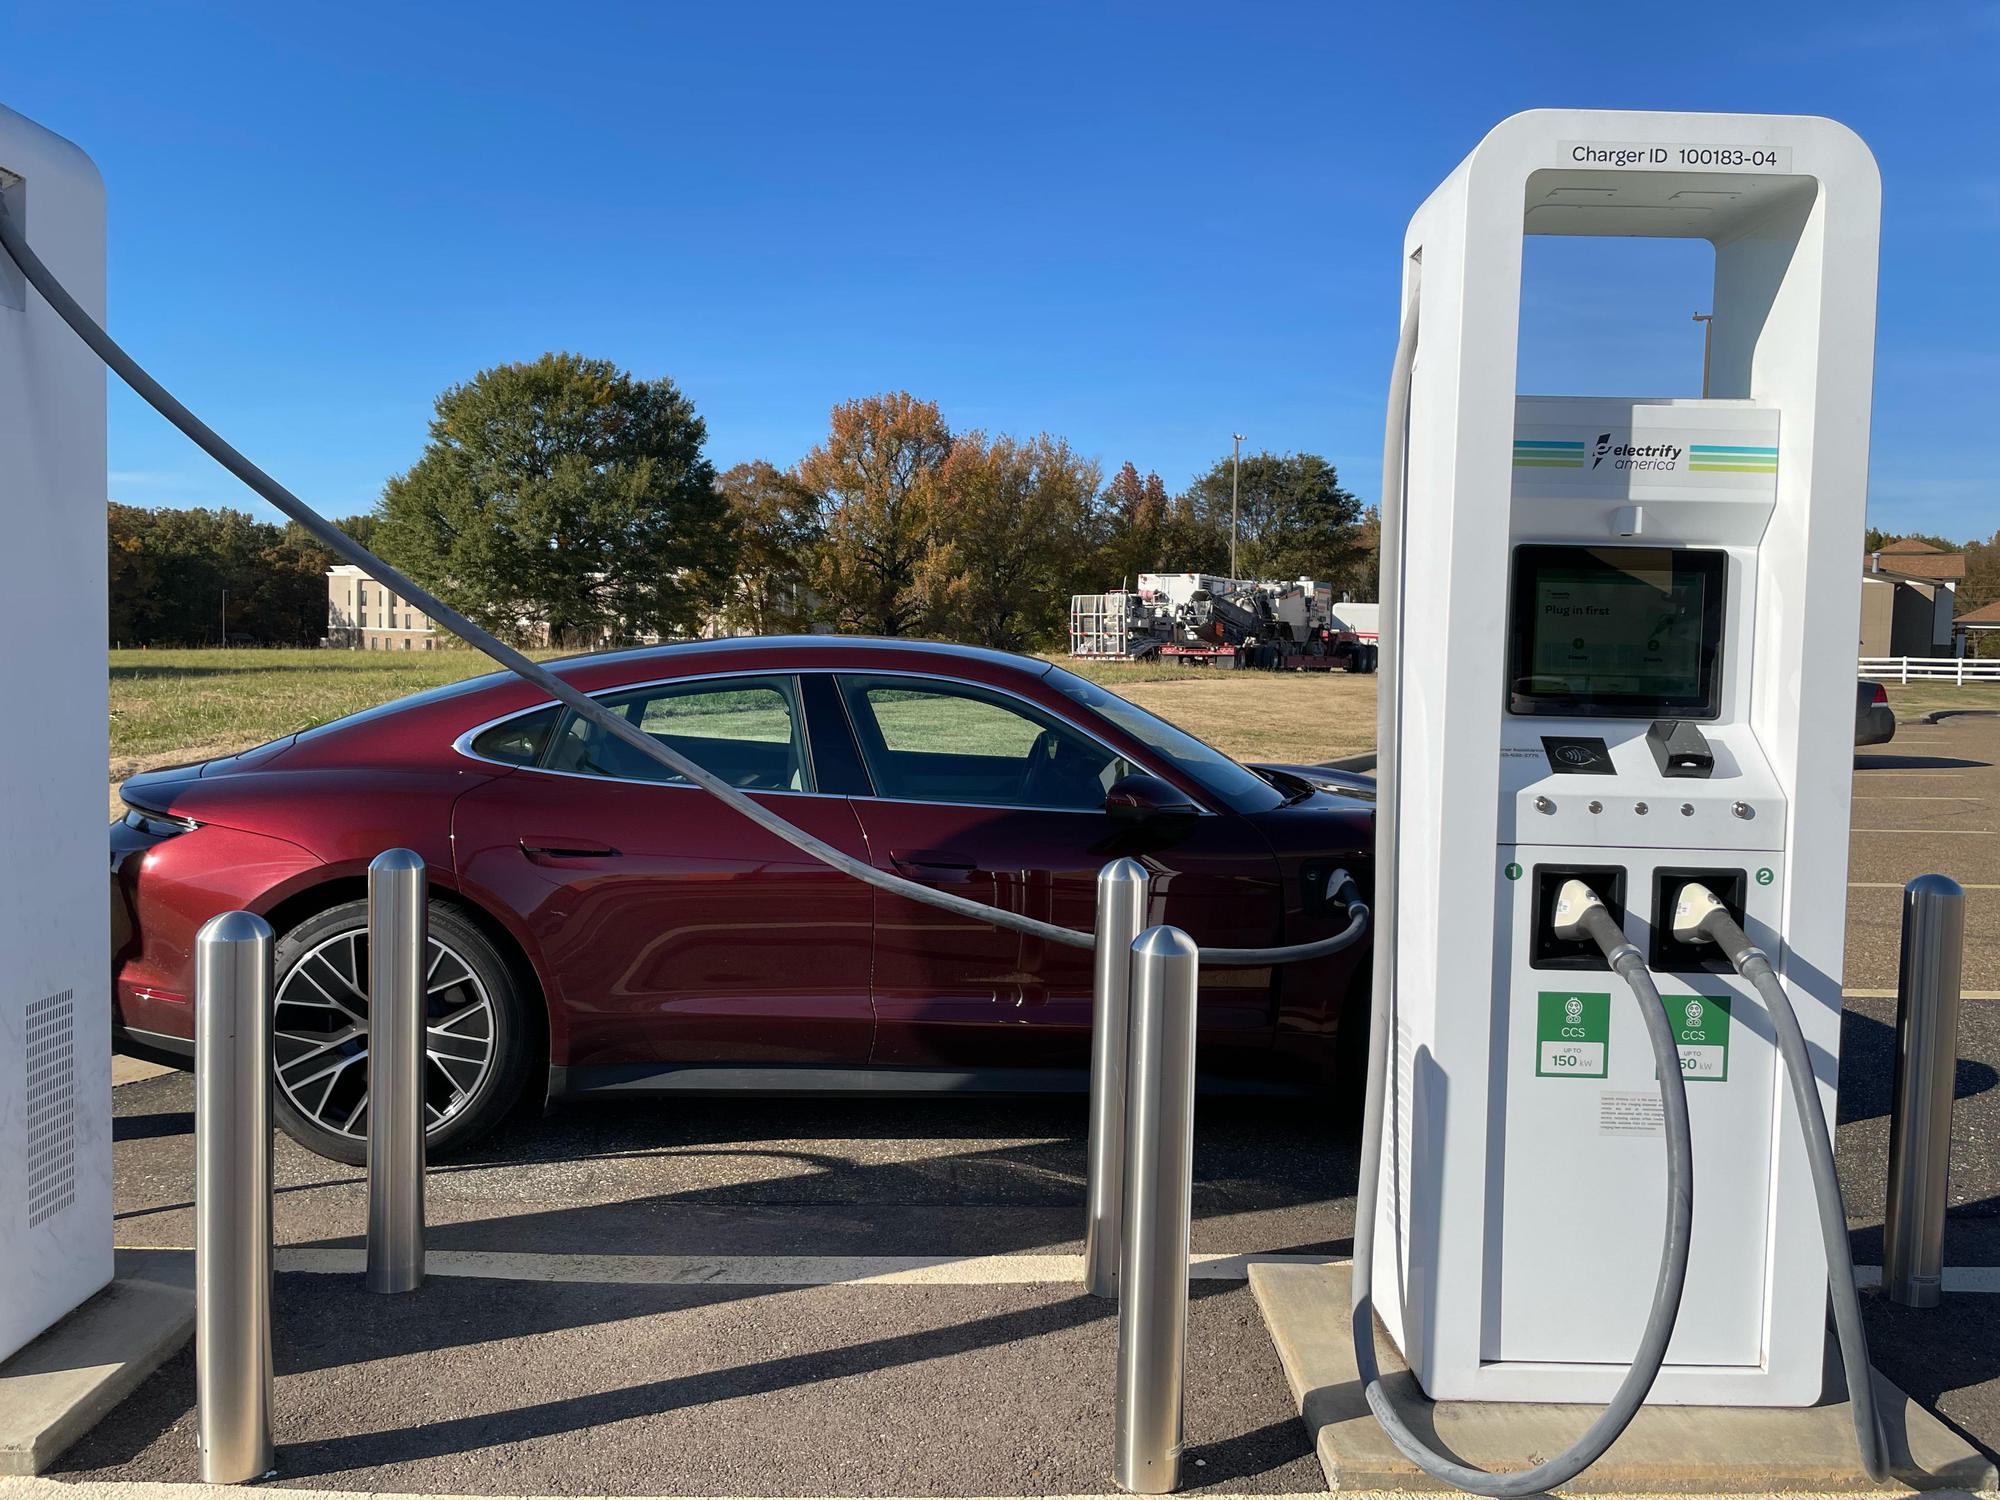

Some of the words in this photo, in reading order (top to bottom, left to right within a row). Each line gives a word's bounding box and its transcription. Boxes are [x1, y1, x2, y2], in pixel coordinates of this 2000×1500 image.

[1572, 146, 1645, 166] Charger
[1649, 148, 1668, 163] ID
[1679, 149, 1777, 166] 100183-04
[1613, 443, 1682, 460] electrify
[1614, 458, 1676, 471] america
[1545, 605, 1570, 616] Plug
[1572, 605, 1583, 615] in
[1586, 605, 1610, 616] first
[1510, 865, 1517, 877] 1
[1759, 870, 1770, 883] 2
[1561, 1027, 1585, 1037] CCS
[1681, 1030, 1706, 1041] CCS
[1552, 1055, 1577, 1067] 150
[1699, 1062, 1713, 1070] kW
